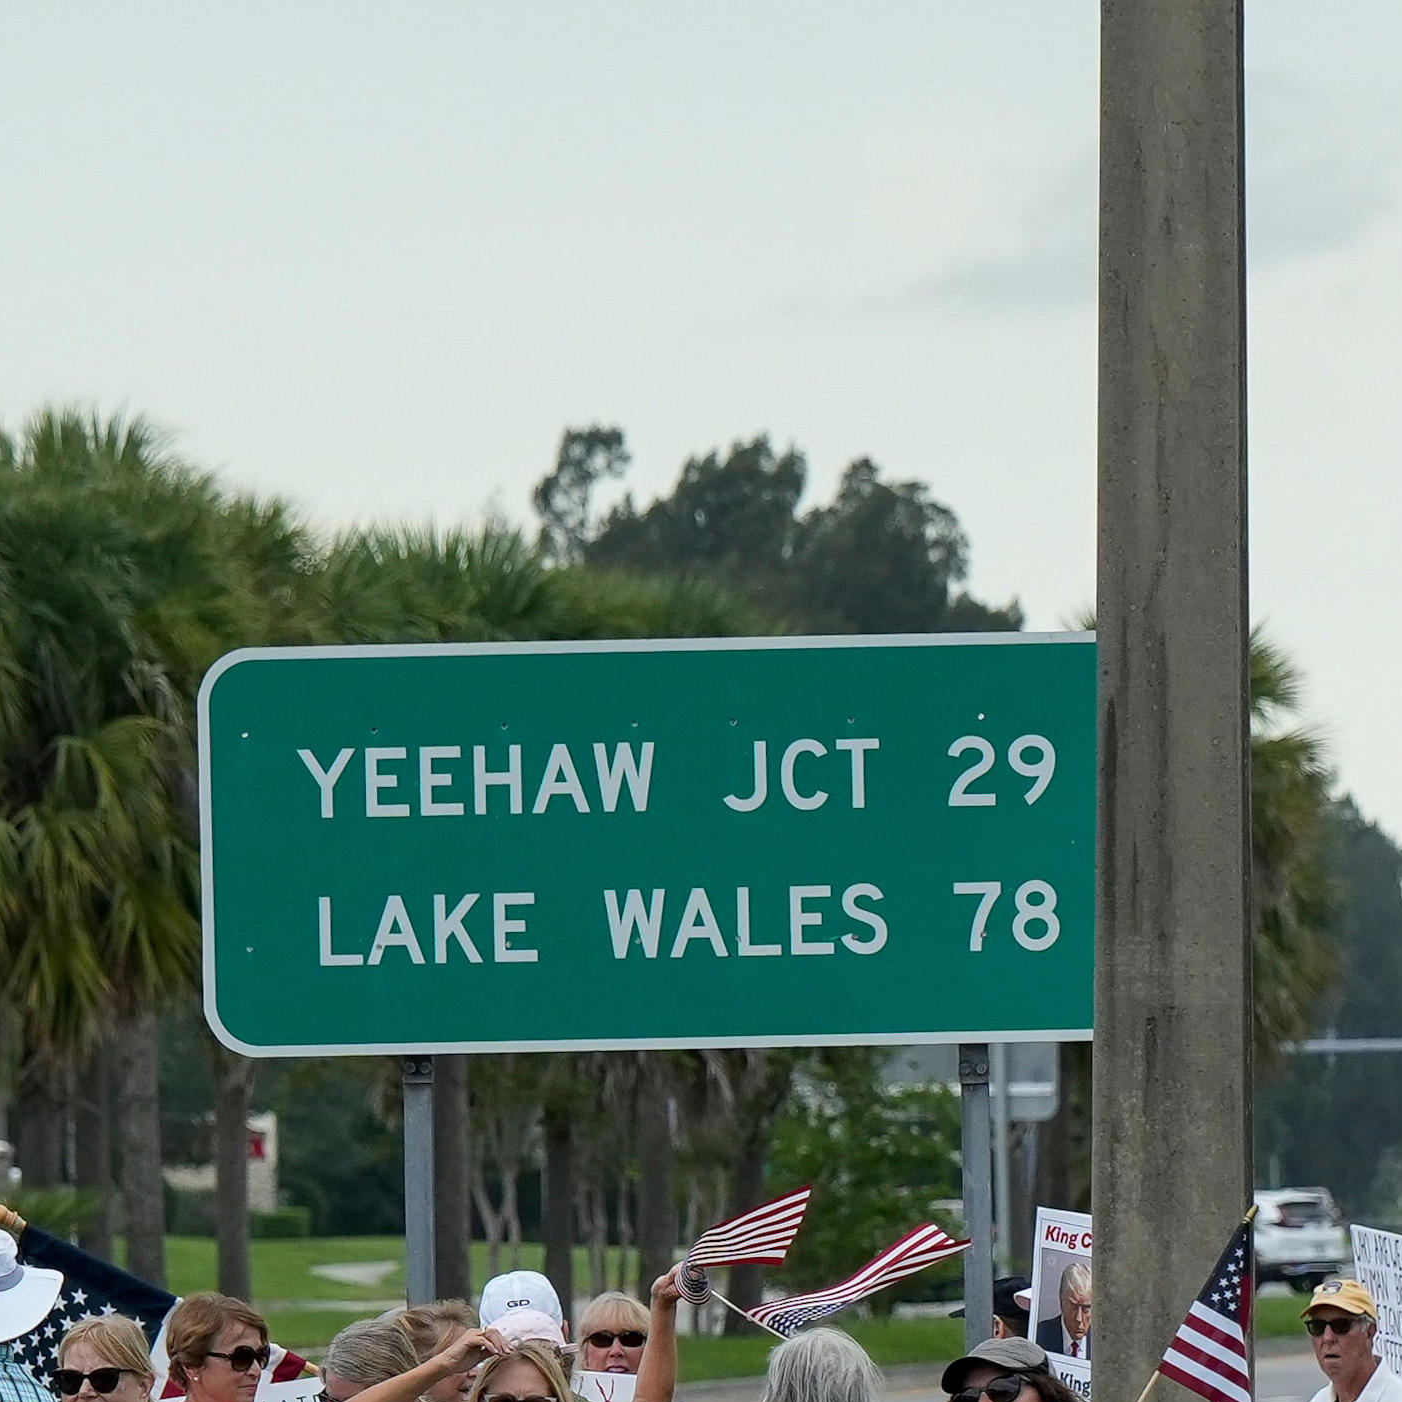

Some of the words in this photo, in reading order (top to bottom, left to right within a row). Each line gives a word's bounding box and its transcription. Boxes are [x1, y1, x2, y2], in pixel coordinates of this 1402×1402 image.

[297, 742, 655, 818] YEEHAW
[723, 738, 880, 812] JCT
[947, 733, 1057, 808] 29
[319, 892, 539, 967] LAKE
[604, 882, 889, 960] WALES
[952, 879, 1061, 953] 78
[1045, 1224, 1079, 1250] King
[1059, 1371, 1091, 1398] King
